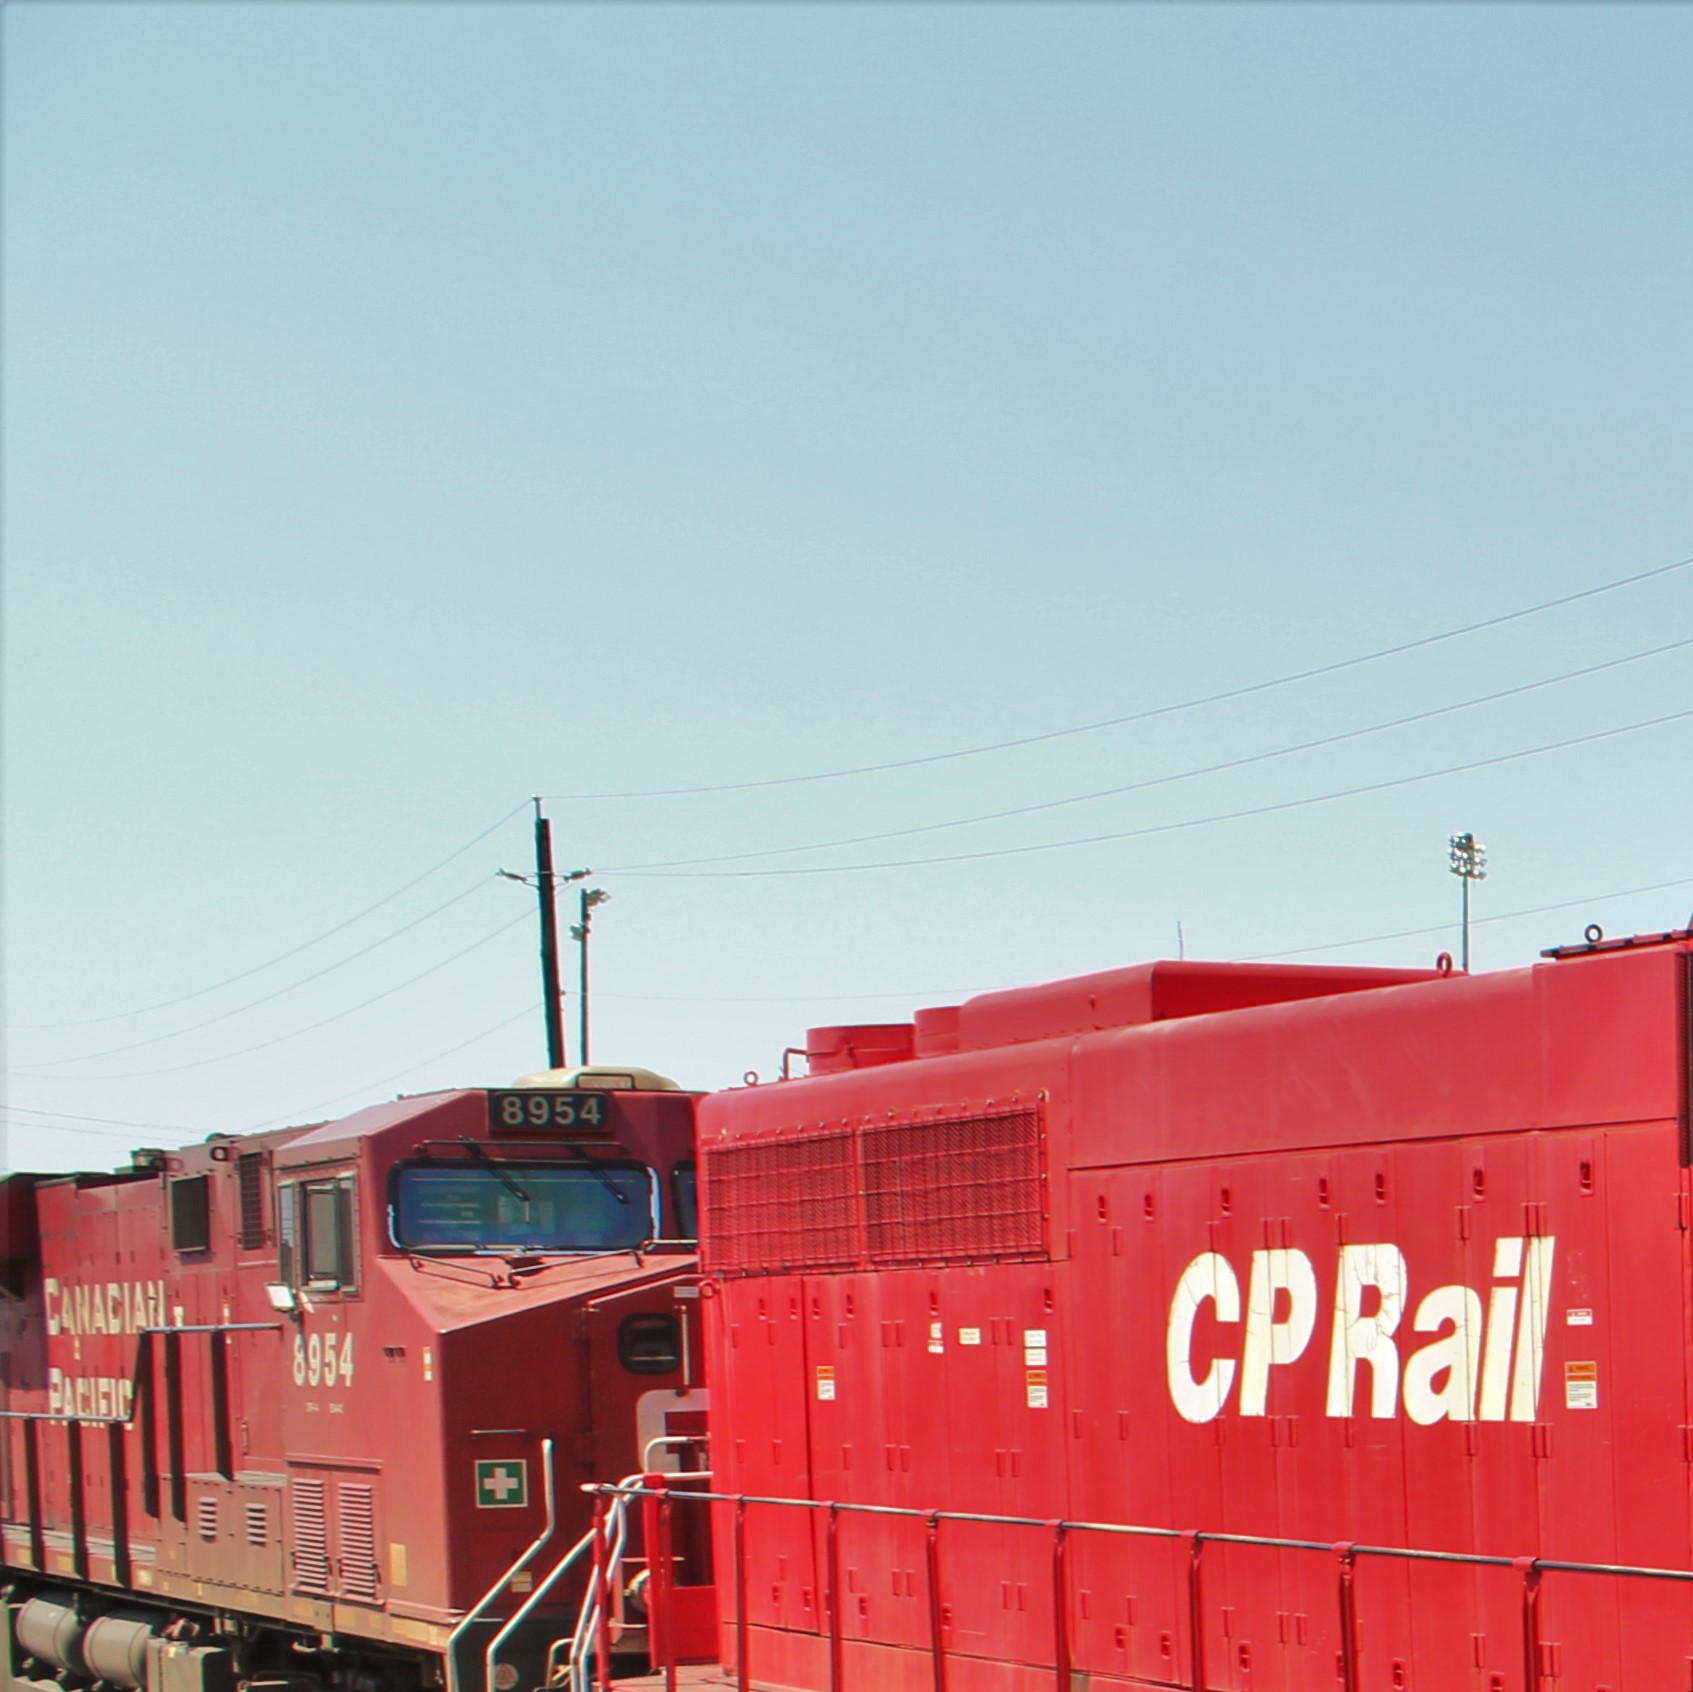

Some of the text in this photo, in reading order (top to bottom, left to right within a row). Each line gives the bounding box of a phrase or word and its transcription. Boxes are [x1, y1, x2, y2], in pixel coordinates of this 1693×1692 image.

[502, 1096, 602, 1125] 8954
[44, 1277, 166, 1336] CANADIAN
[1167, 1236, 1556, 1427] CP Rail
[293, 1332, 354, 1388] 8954
[48, 1366, 135, 1431] PACIFIC
